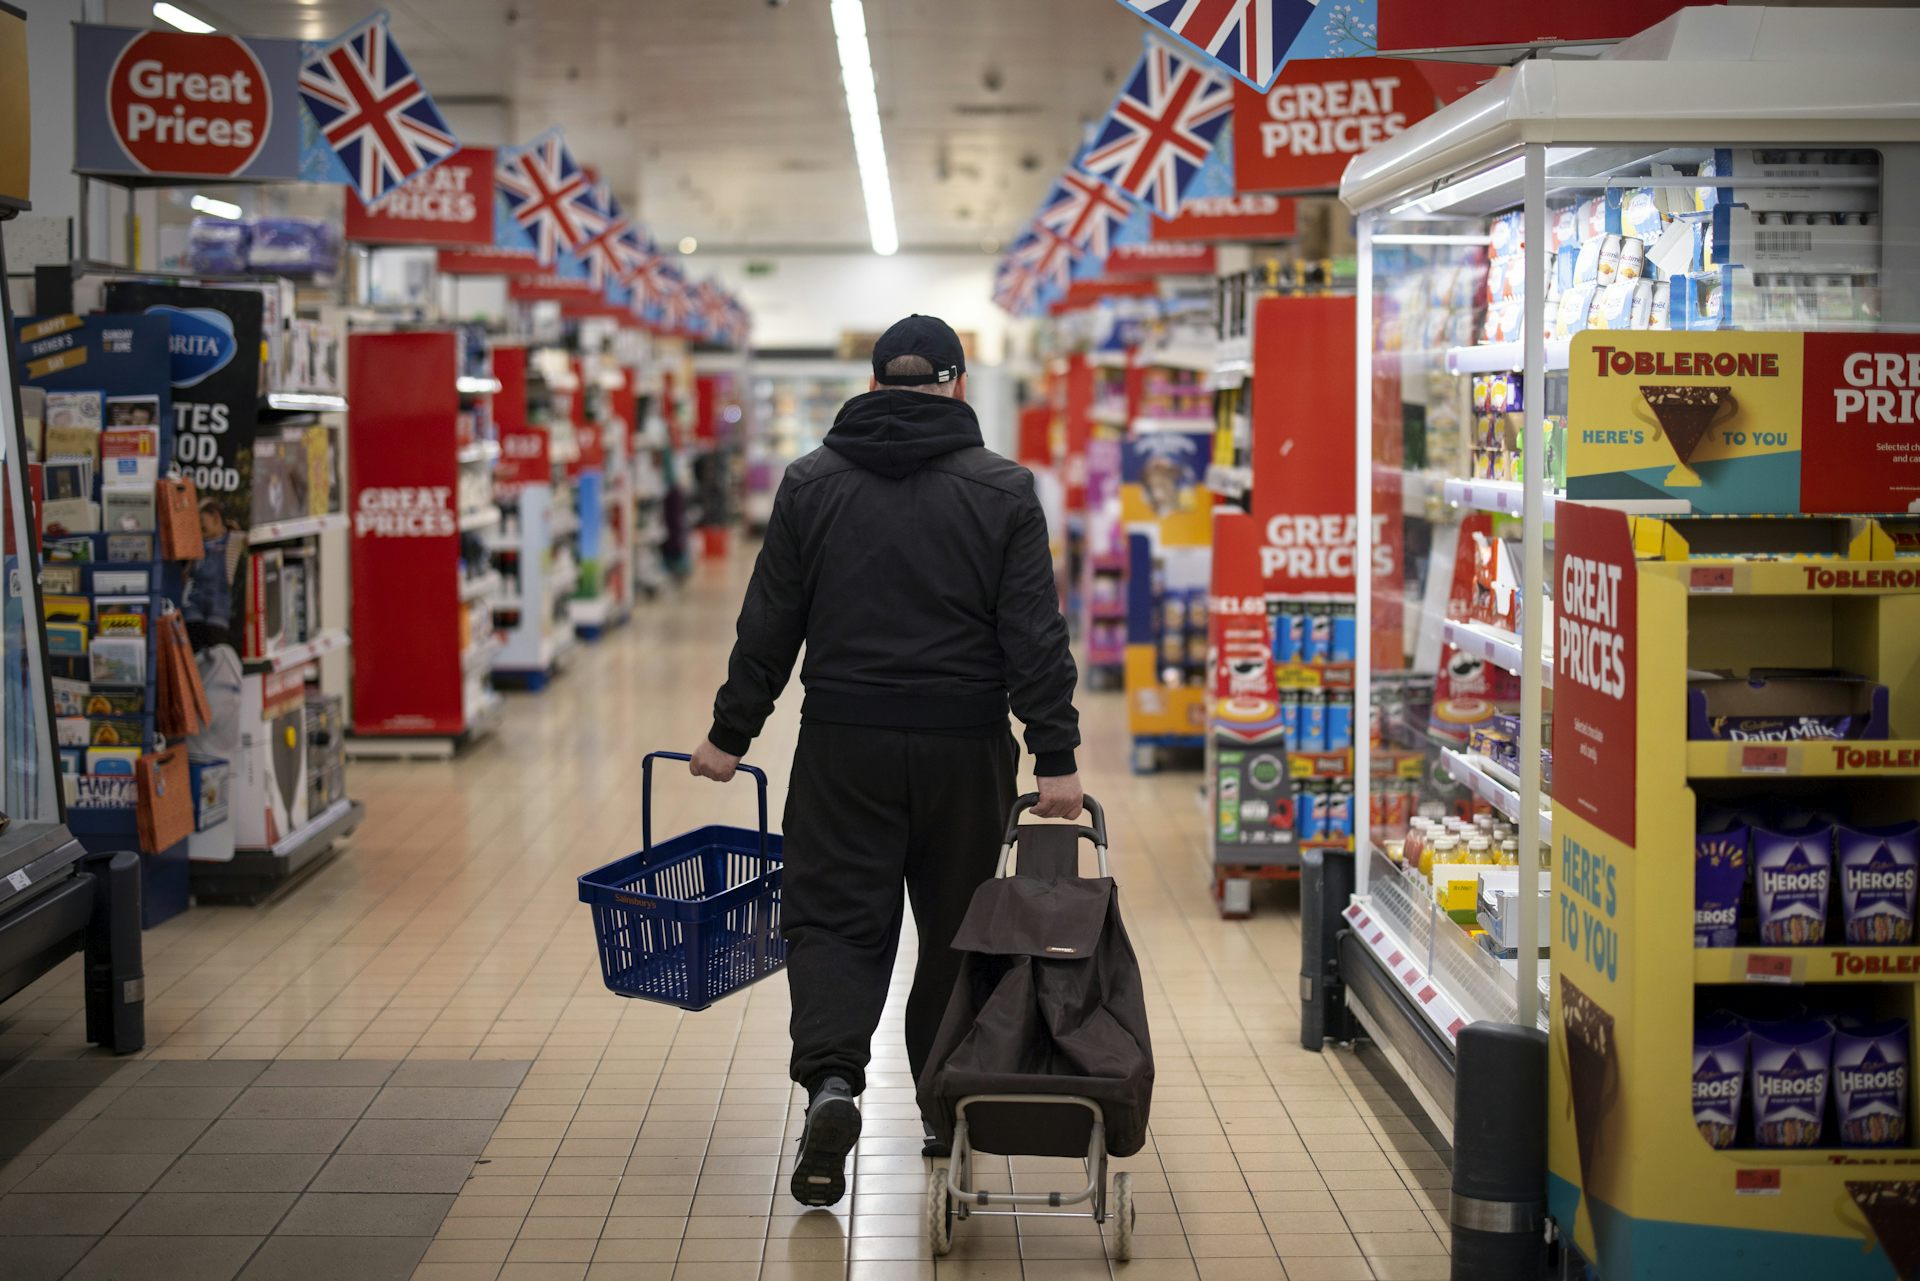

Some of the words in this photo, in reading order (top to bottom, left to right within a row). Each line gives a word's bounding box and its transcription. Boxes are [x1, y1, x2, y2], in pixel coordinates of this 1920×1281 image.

[128, 60, 252, 103] Great
[1267, 76, 1400, 121] GREAT
[127, 104, 254, 148] Prices
[1260, 112, 1406, 158] PRICES
[1592, 346, 1779, 377] TOBLERONE
[1834, 389, 1920, 424] PRI
[1582, 430, 1645, 445] HERE'S
[1723, 432, 1746, 446] TO
[1752, 432, 1788, 446] YOU
[1876, 442, 1910, 452] Selected
[1892, 454, 1908, 463] and
[360, 487, 450, 511] GREAT
[356, 510, 456, 538] PRICES
[1562, 554, 1622, 628] GREAT
[1559, 616, 1625, 700] PRICES
[1562, 834, 1617, 919] HERE'S
[1764, 869, 1827, 893] HEROES
[1849, 869, 1914, 890] HEROES
[1695, 907, 1736, 925] EROES
[1560, 891, 1579, 952] TO
[1583, 909, 1618, 983] YOU
[1693, 1077, 1739, 1098] EROES
[1759, 1074, 1824, 1097] HEROES
[1841, 1066, 1904, 1092] HEROES
